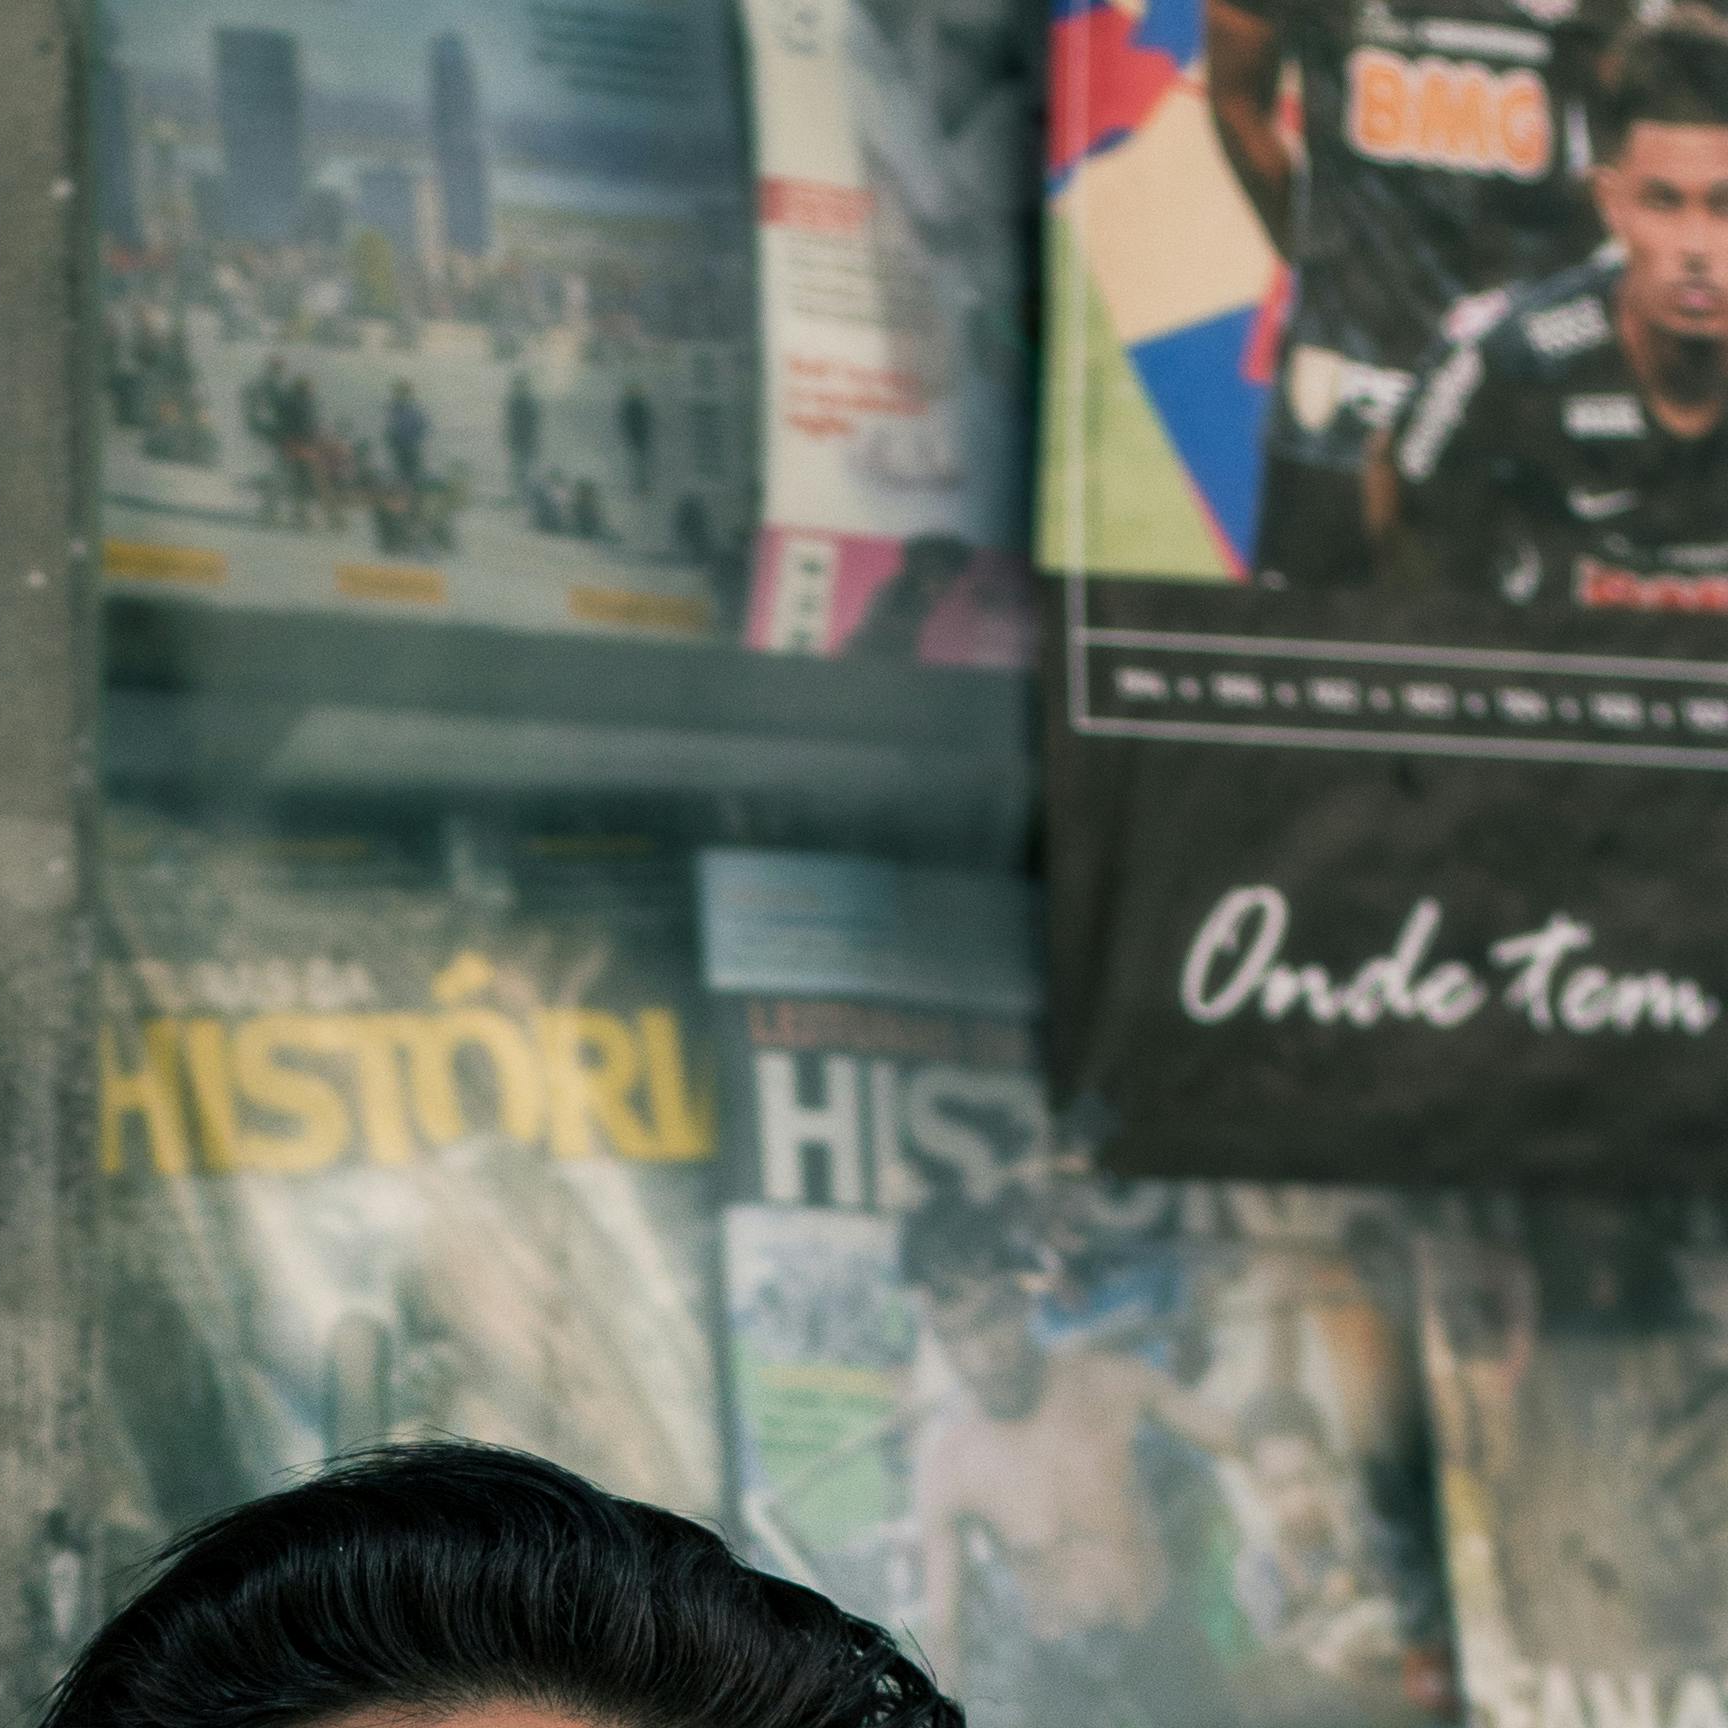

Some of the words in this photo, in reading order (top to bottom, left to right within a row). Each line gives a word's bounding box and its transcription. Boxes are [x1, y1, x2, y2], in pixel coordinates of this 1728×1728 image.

[1352, 52, 1550, 178] BMG
[1181, 885, 1486, 1030] Onde
[1489, 912, 1721, 1036] tem
